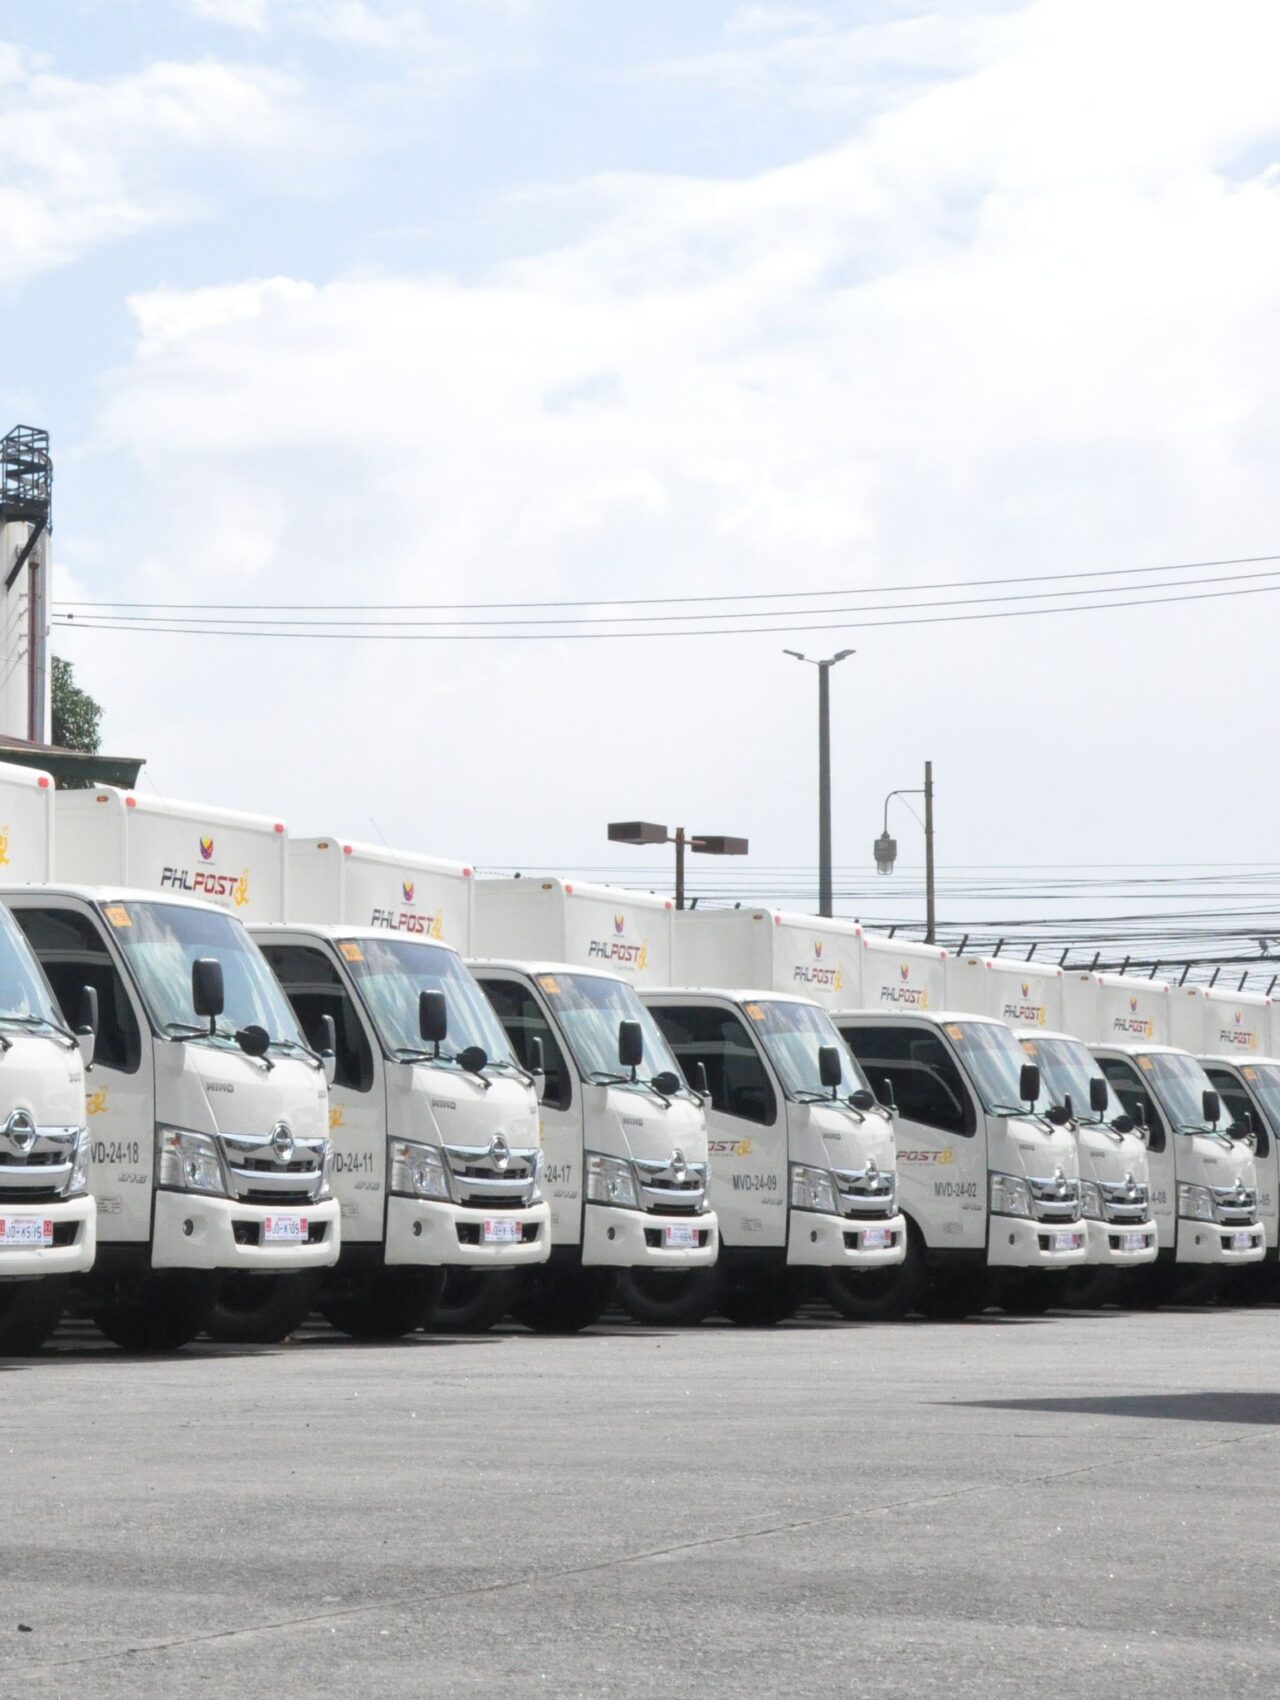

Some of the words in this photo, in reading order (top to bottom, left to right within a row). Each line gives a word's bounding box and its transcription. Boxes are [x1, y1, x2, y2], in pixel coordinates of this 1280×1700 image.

[161, 867, 238, 896] PHLPOST
[371, 909, 434, 935] PHLPOST
[588, 940, 640, 962] PHLPOST
[793, 966, 836, 985] PHLPOST
